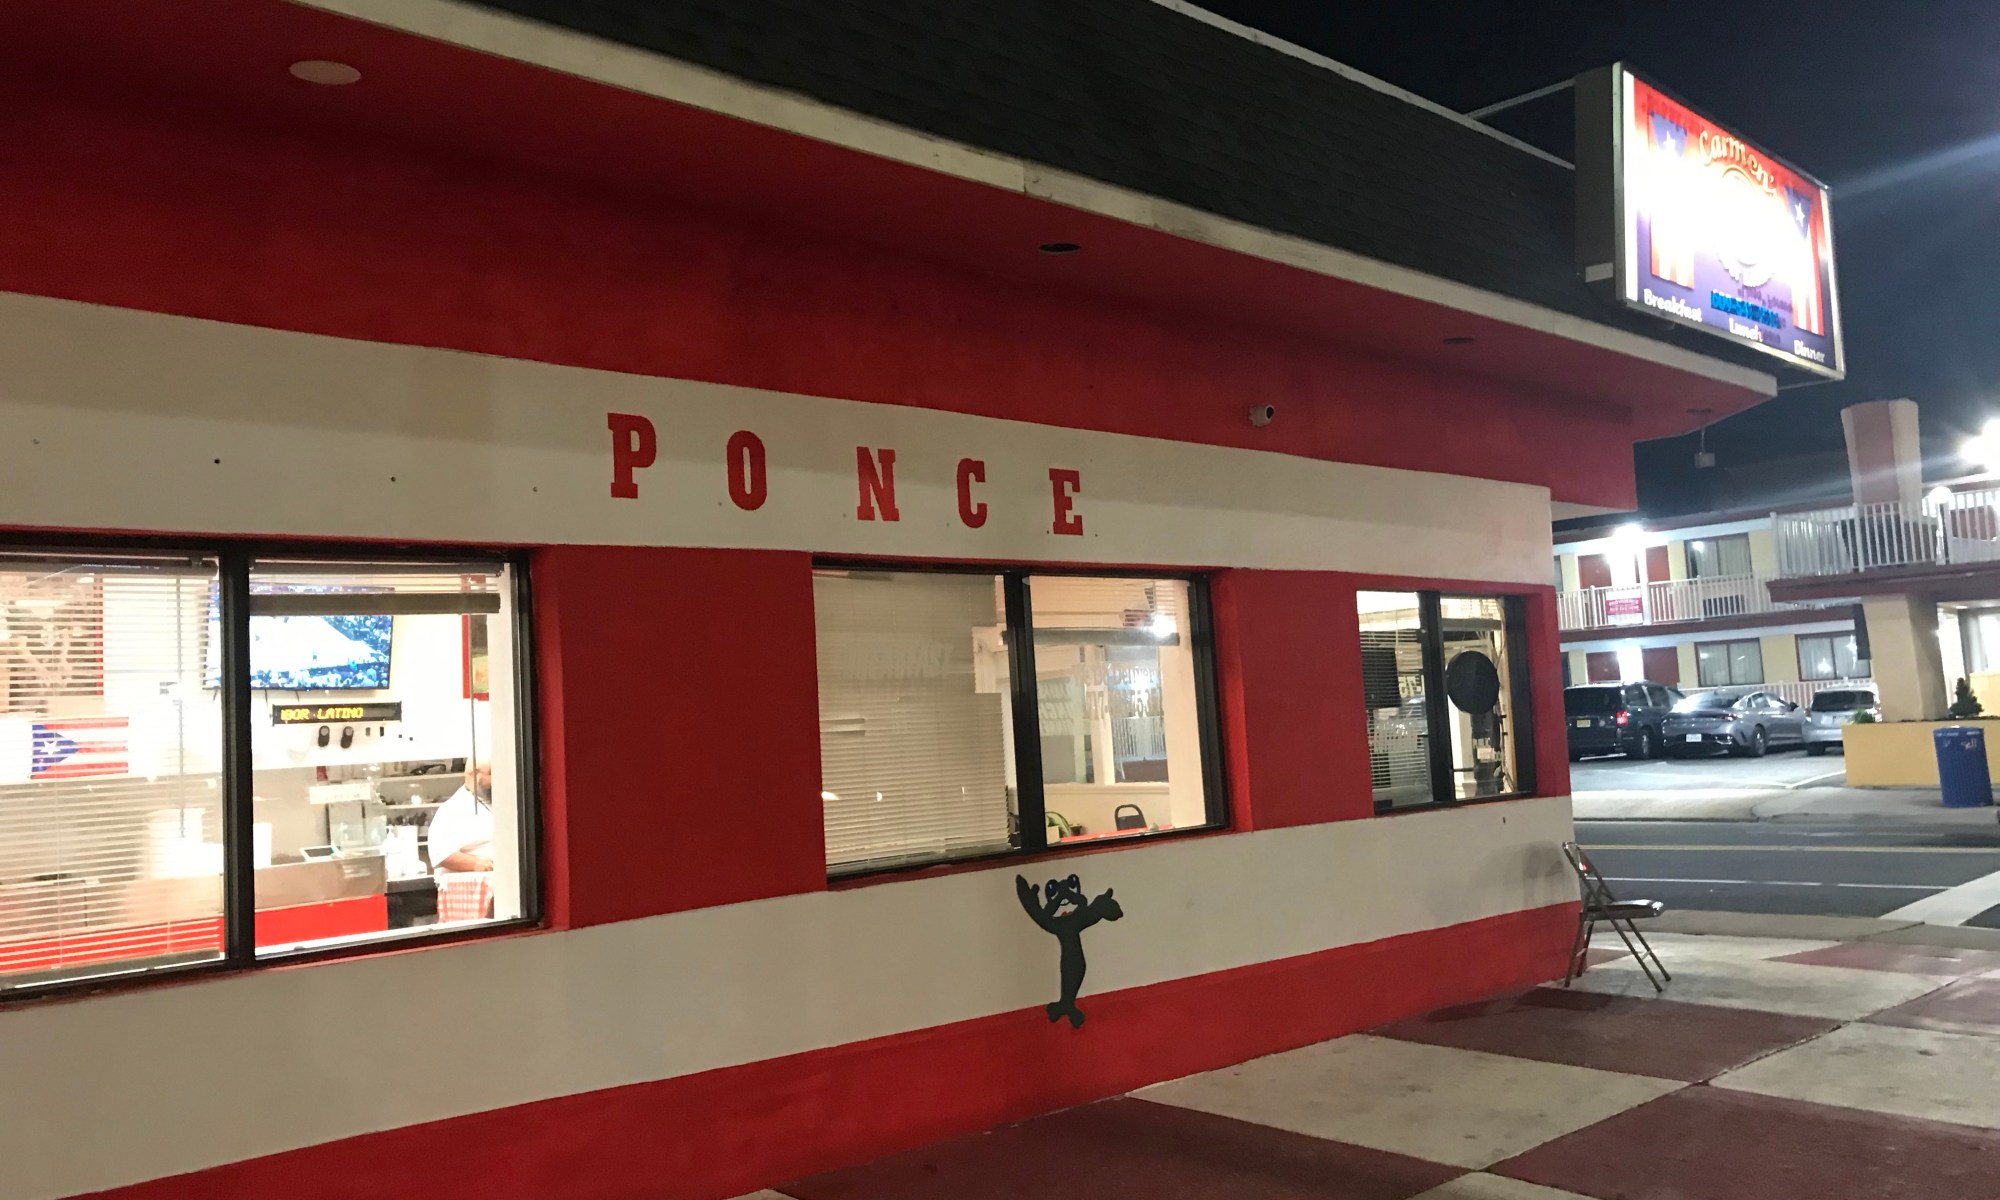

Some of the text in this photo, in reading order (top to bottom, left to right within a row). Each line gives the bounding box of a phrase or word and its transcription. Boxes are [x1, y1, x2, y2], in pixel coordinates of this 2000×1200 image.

[1643, 288, 1702, 323] Breakfast
[1729, 317, 1763, 342] Lunch
[1794, 339, 1826, 363] Dinner
[607, 412, 1083, 536] PONCE
[317, 706, 364, 720] LATINO
